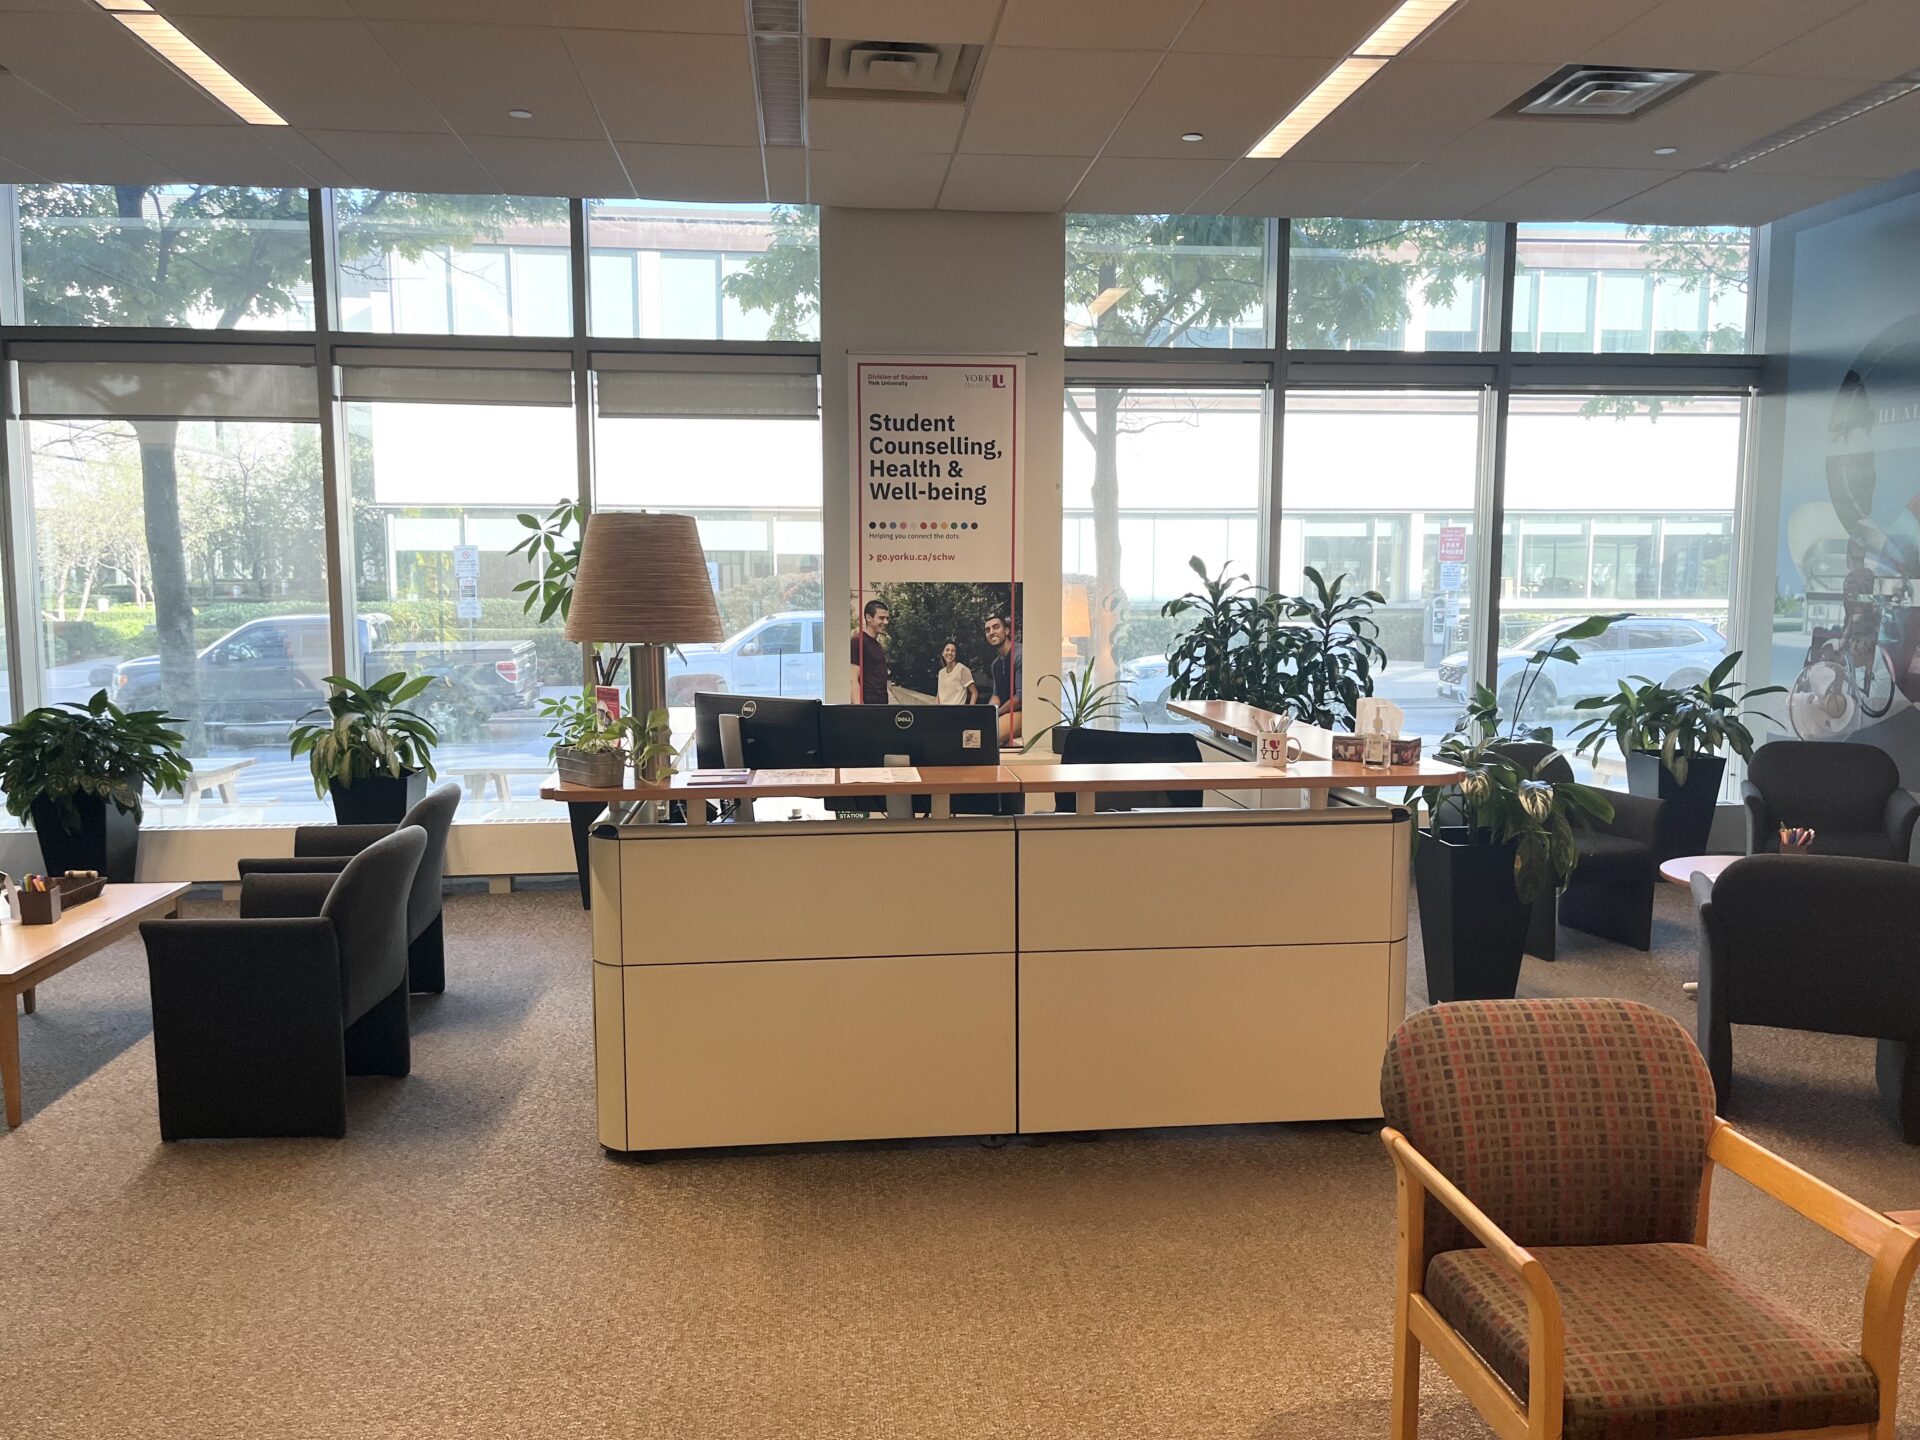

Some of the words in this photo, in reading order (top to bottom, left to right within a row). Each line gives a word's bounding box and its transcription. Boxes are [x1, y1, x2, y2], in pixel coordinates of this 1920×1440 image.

[964, 374, 991, 383] YORK
[869, 413, 955, 432] Student
[869, 437, 1003, 460] Counselling,
[869, 460, 941, 478] Health
[947, 460, 963, 478] &
[869, 482, 987, 506] Well-being
[869, 532, 893, 540] Helping
[876, 552, 956, 562] go.yorku.ca/schw
[1262, 739, 1267, 749] I
